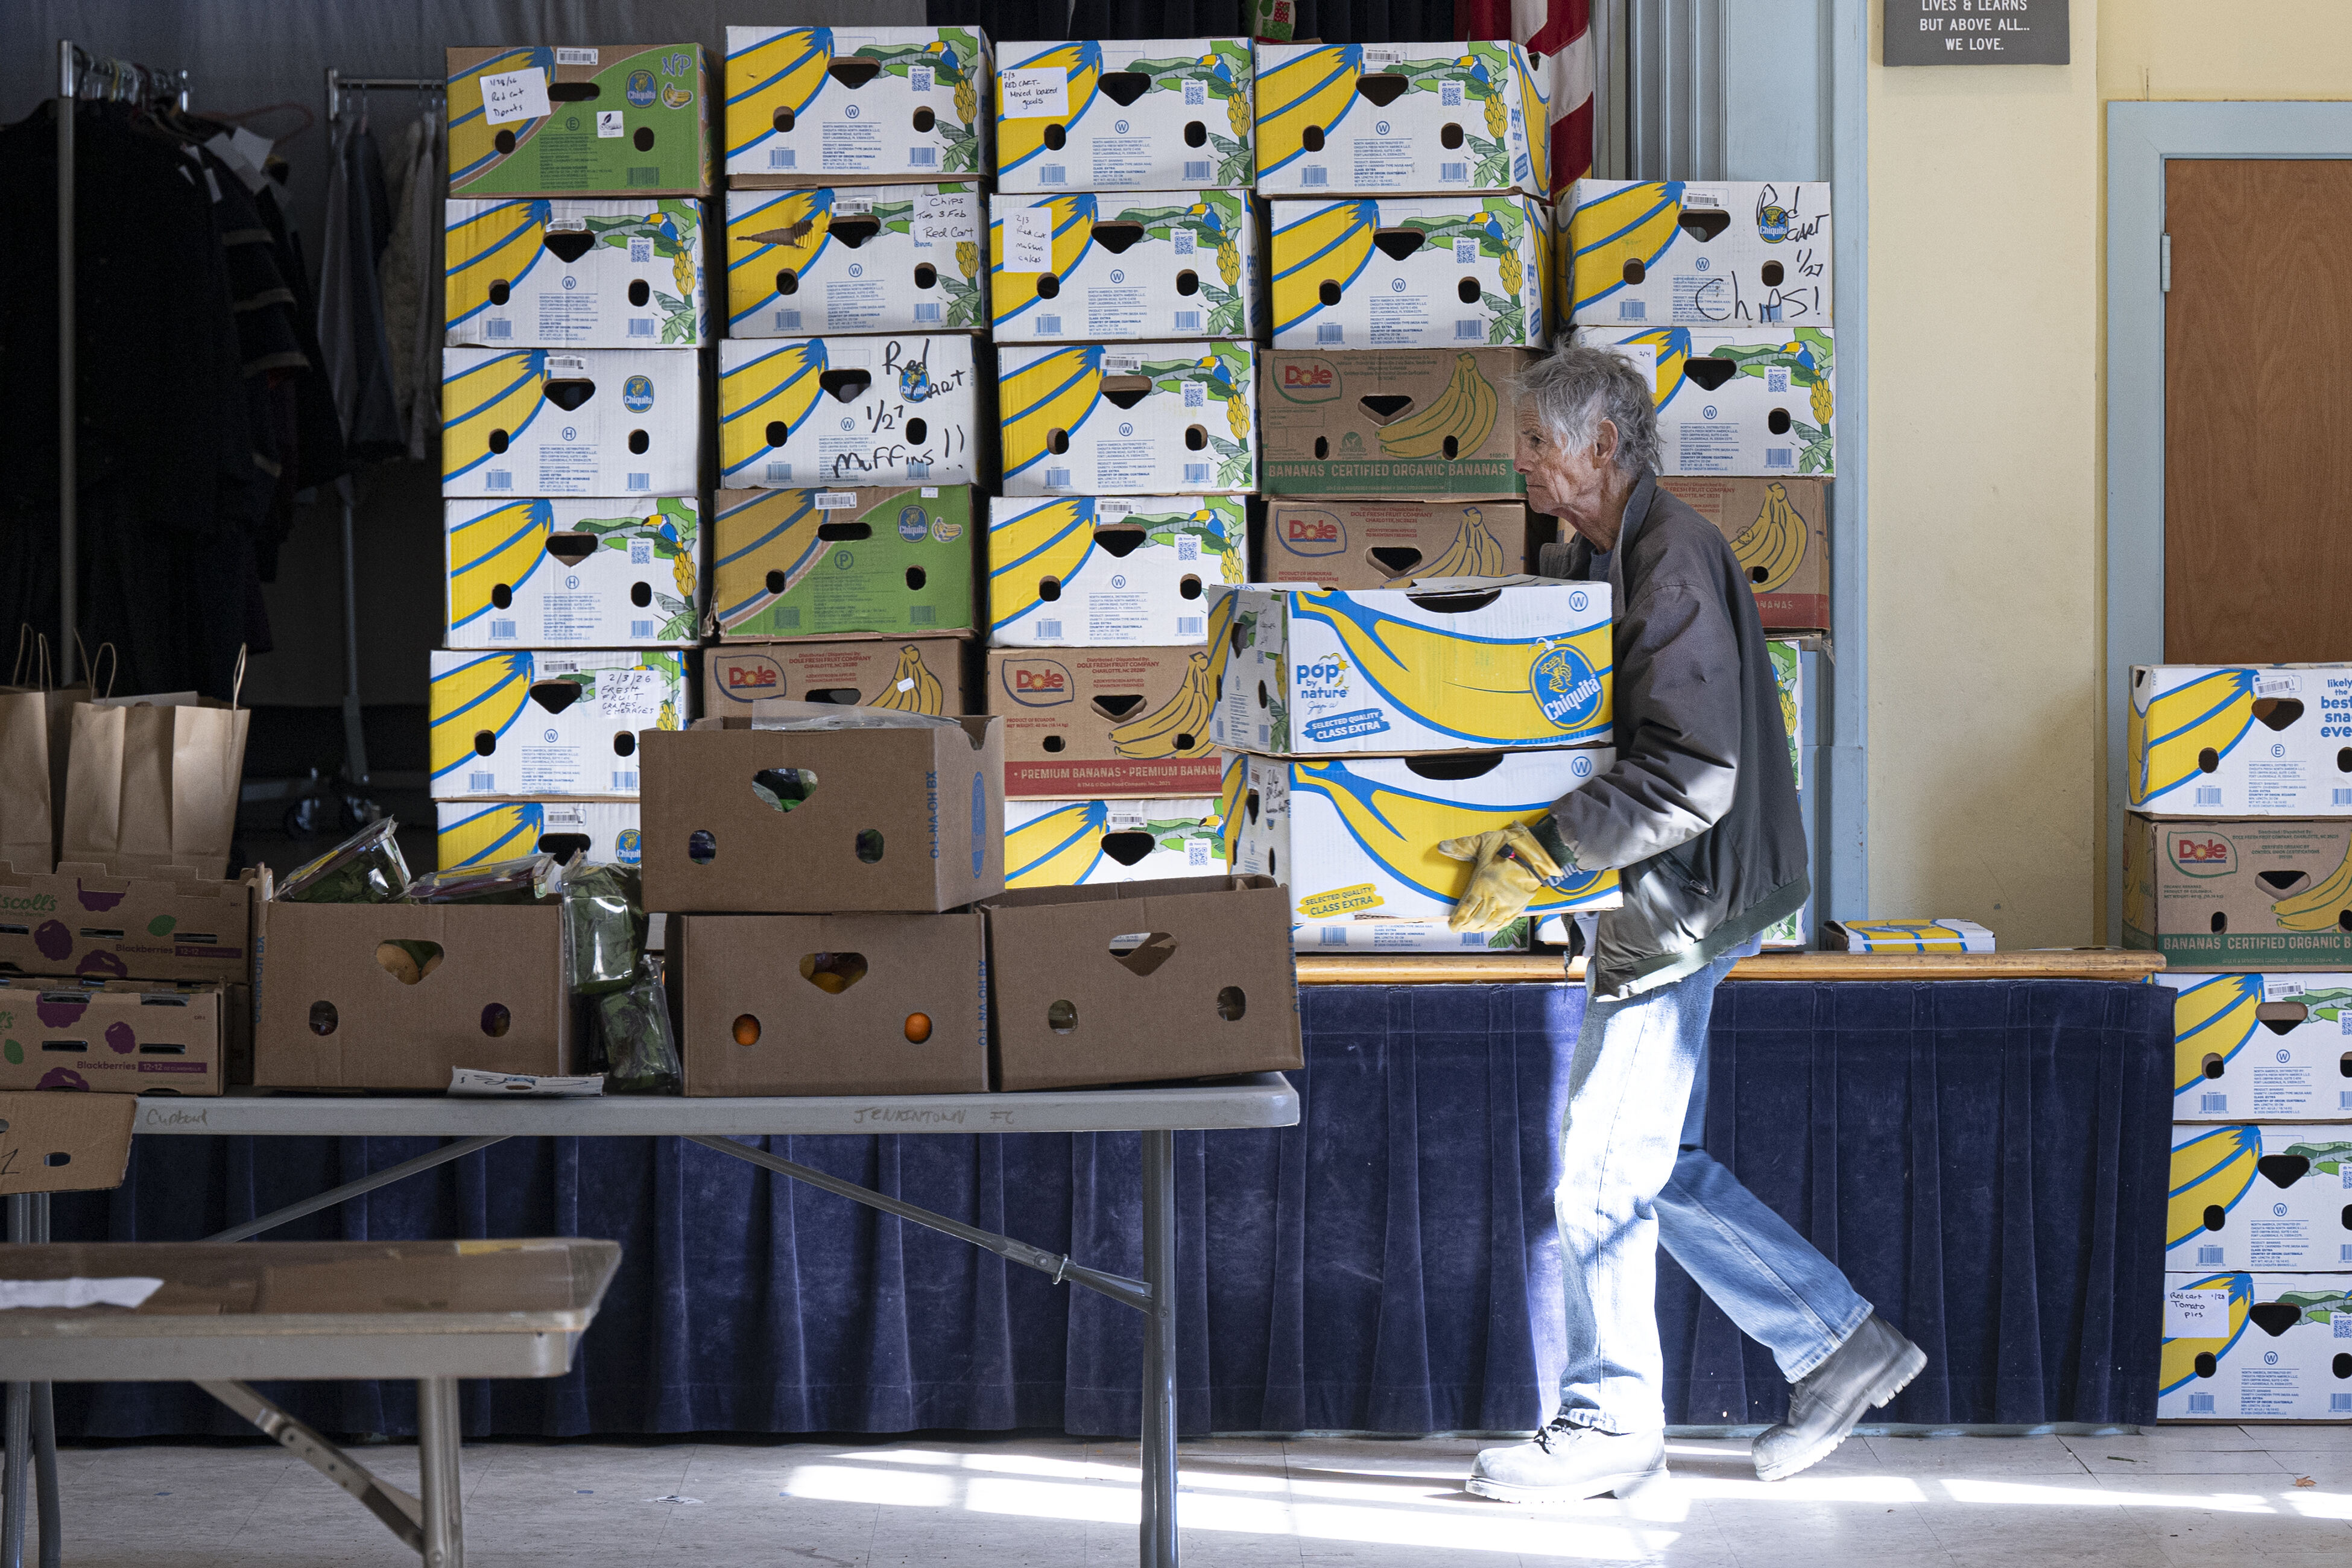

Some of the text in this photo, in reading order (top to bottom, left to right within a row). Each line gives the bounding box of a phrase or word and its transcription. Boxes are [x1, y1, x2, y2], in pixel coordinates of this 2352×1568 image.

[1922, 0, 2027, 10] LIVES & LEARNS
[1920, 19, 2029, 30] BUT ABOVE ALL...
[1946, 39, 2003, 50] WE LOVE.
[1004, 72, 1016, 80] 2/3
[492, 92, 505, 102] Red
[628, 90, 656, 101] Chiquita
[1010, 87, 1058, 97] Mixed baked
[493, 103, 522, 117] Donuts
[1023, 98, 1043, 110] goods
[930, 198, 964, 206] Chips
[1756, 183, 1800, 226] Red
[947, 209, 966, 218] Feb
[1016, 214, 1029, 225] 2/3
[923, 226, 974, 238] Red Cart
[1760, 226, 1788, 237] Chiquita
[882, 338, 930, 376] Red
[1284, 364, 1332, 387] Dole
[624, 395, 653, 407] Chiquita
[866, 399, 903, 434] 1/27
[1269, 463, 1506, 477] BANANAS CERTIFIED ORGANIC BANANAS
[899, 524, 928, 536] Chiquita
[1289, 519, 1338, 539] Dole
[609, 672, 651, 686] 2/3/26
[729, 666, 777, 685] Dole
[1016, 669, 1065, 689] Dole
[1297, 663, 1339, 685] pop
[601, 684, 639, 695] FRESH
[1306, 679, 1318, 689] by
[2327, 678, 2352, 689] likely
[1301, 688, 1347, 699] nature
[1543, 674, 1602, 722] Chiquita
[1312, 712, 1380, 730] SELECTED QUALITY
[2325, 712, 2352, 723] sna
[1317, 721, 1381, 740] CLASS EXTRA
[2320, 726, 2352, 738] eve
[1021, 765, 1222, 779] PREMIUM BANANAS PREMIUM BANANA
[925, 770, 938, 789] BX
[616, 849, 640, 859] Chiquit
[2179, 839, 2227, 859] Dole
[1306, 887, 1371, 906] SELECTED QUALITY
[1310, 896, 1374, 915] CLASS EXTRA
[116, 943, 174, 954] Blackberries
[2164, 937, 2221, 950] BANANAS
[2227, 937, 2285, 949] CERTIFIED
[2289, 936, 2340, 949] ORGANIC
[77, 1061, 163, 1071] Blackberries 12-12
[2170, 1292, 2184, 1300] Red
[2171, 1300, 2205, 1310] Tomato
[2184, 1310, 2203, 1319] pies
